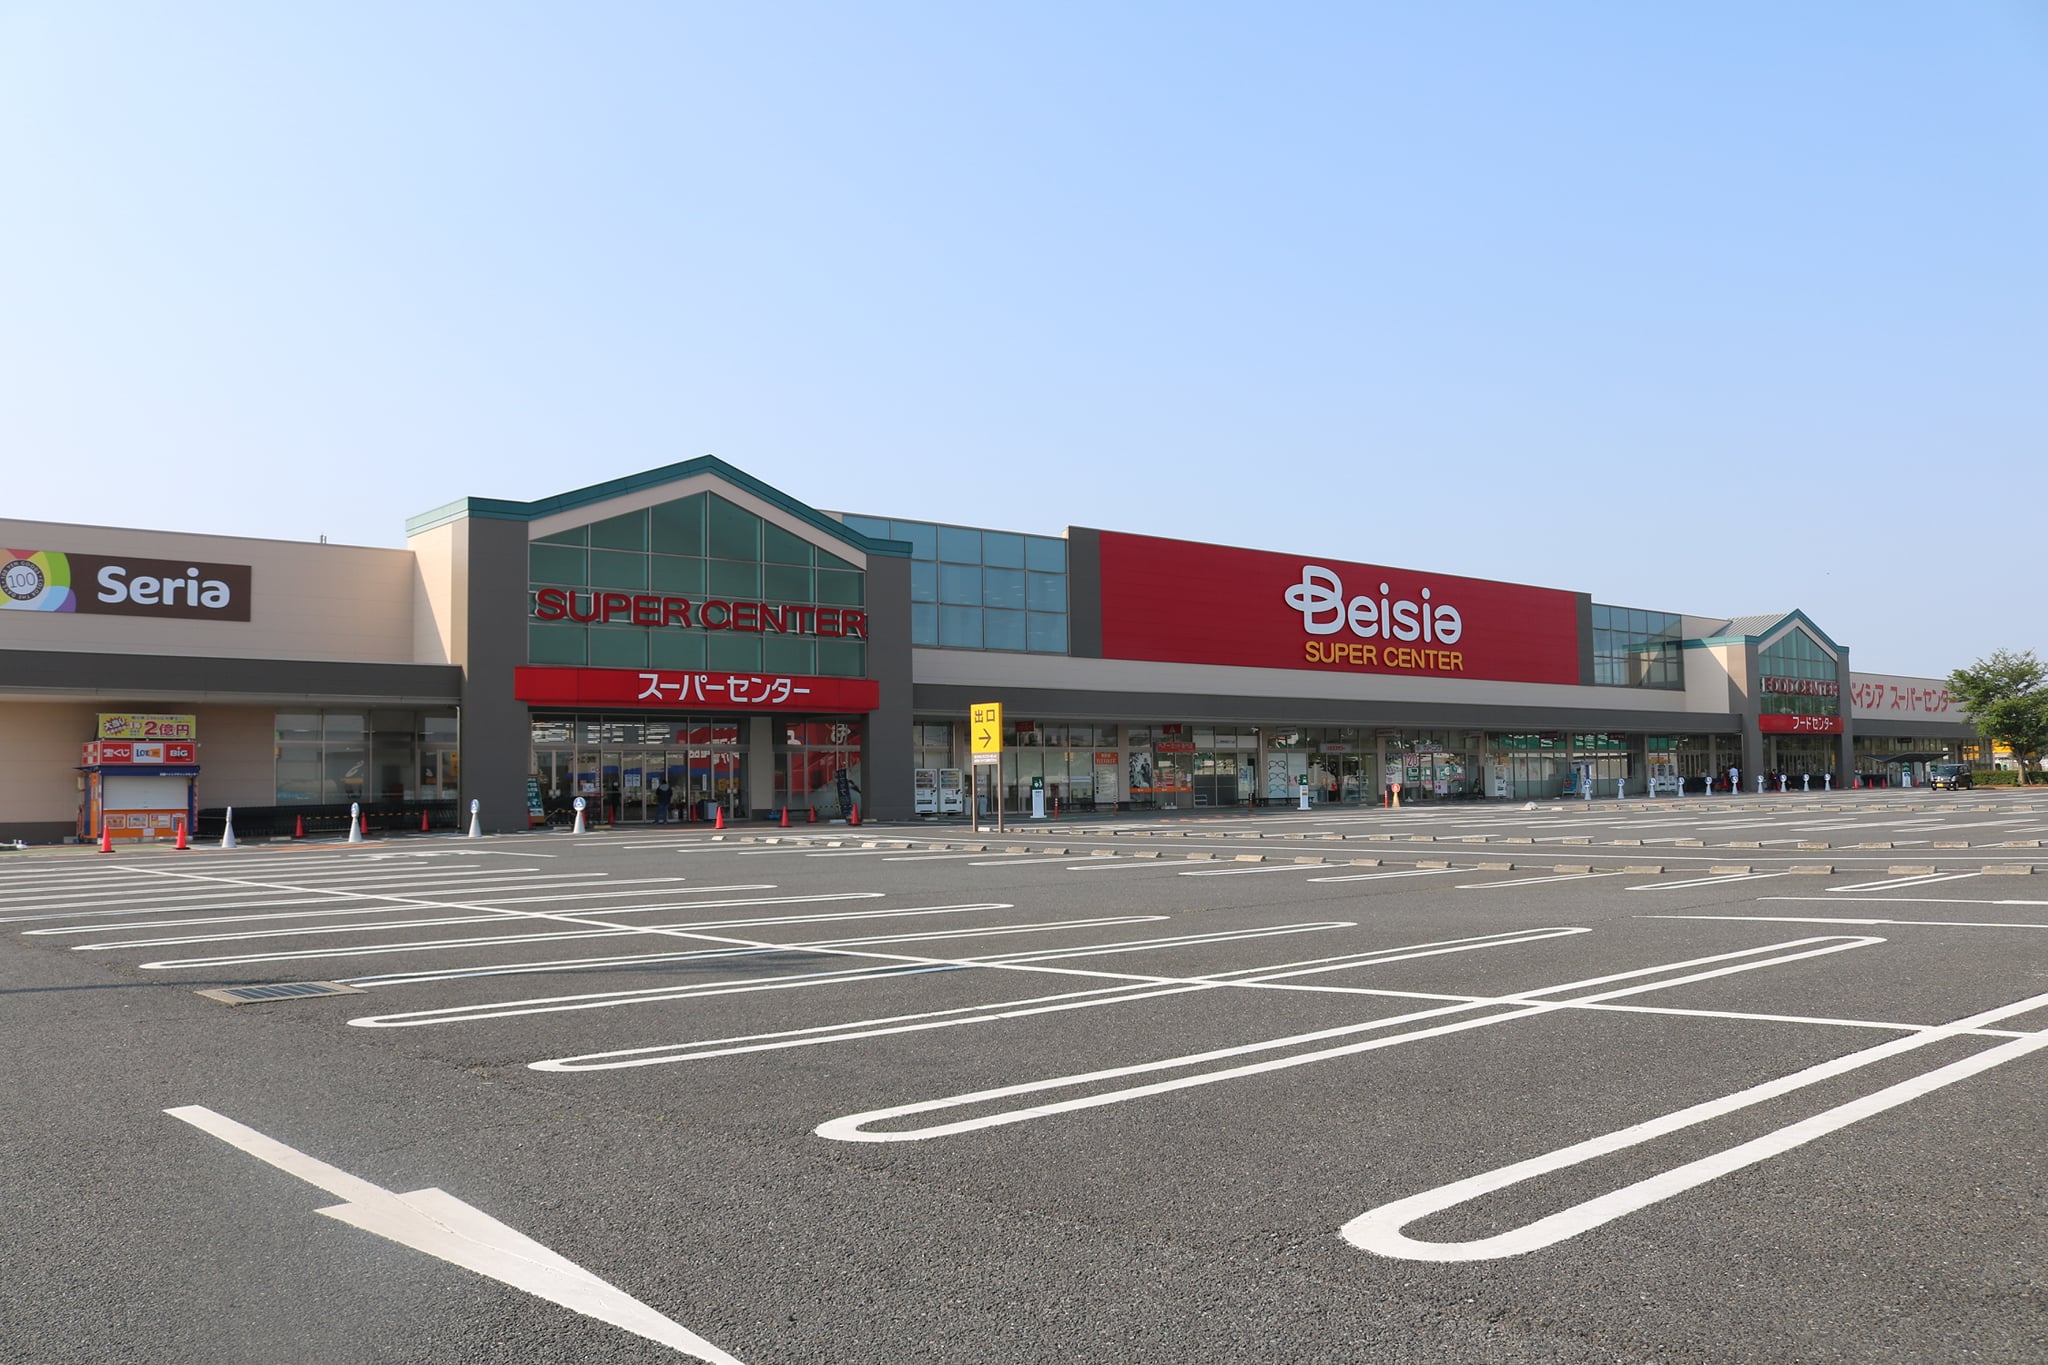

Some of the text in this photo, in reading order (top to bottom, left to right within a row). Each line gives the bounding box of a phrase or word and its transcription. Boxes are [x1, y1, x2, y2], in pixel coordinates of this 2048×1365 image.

[8, 572, 36, 588] 100
[97, 566, 230, 608] Seria
[535, 588, 868, 639] SUPER CENTER
[1284, 566, 1462, 644] Beisia
[1305, 640, 1464, 671] SUPER CENTER
[638, 673, 811, 704] スーパーセンター
[1762, 677, 1840, 696] FOOD CENTER
[1890, 686, 1957, 711] スーパーセンター
[144, 721, 190, 736] 2億円
[975, 709, 995, 723] 出口
[1792, 715, 1834, 731] フードセンター
